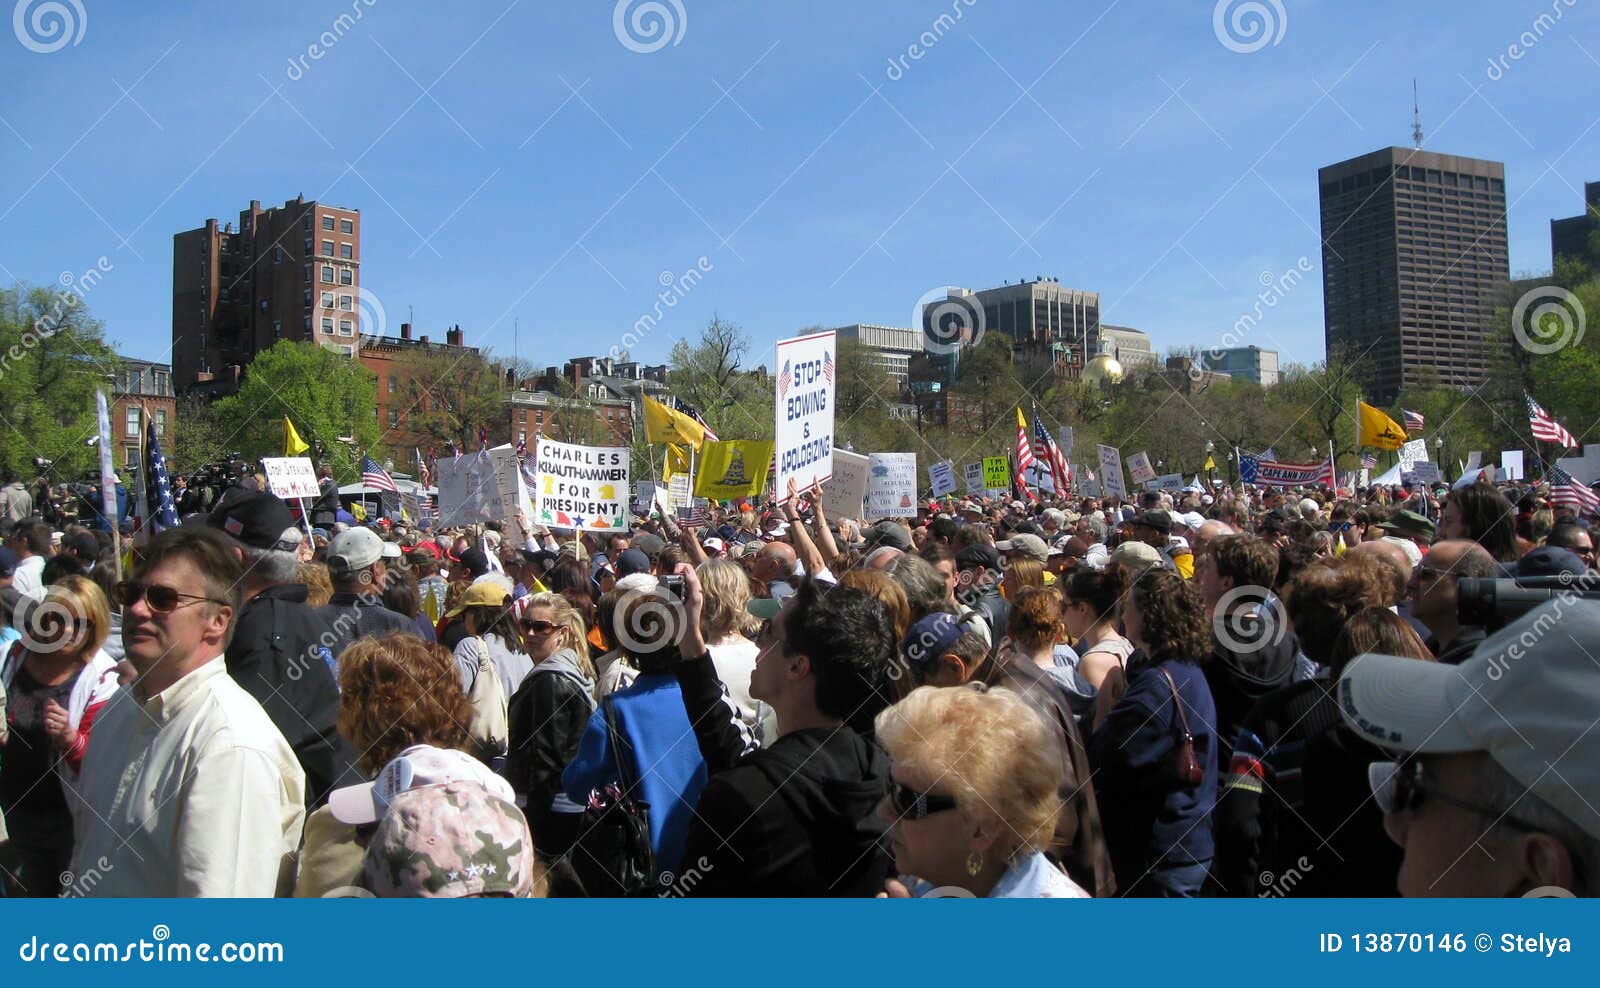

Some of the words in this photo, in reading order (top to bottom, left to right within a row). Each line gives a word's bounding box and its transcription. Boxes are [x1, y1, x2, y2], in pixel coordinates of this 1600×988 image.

[794, 359, 821, 387] STOP
[787, 388, 826, 421] BOWING
[803, 422, 810, 438] &
[543, 445, 620, 465] CHARLES
[781, 435, 830, 475] APOLOGIZING
[538, 460, 626, 480] KRAUTHAMMER
[1262, 468, 1280, 477] CAPE
[1282, 469, 1298, 479] ANN
[559, 483, 590, 498] FOR
[986, 480, 1007, 488] HELL
[543, 497, 618, 515] PRESIDENT
